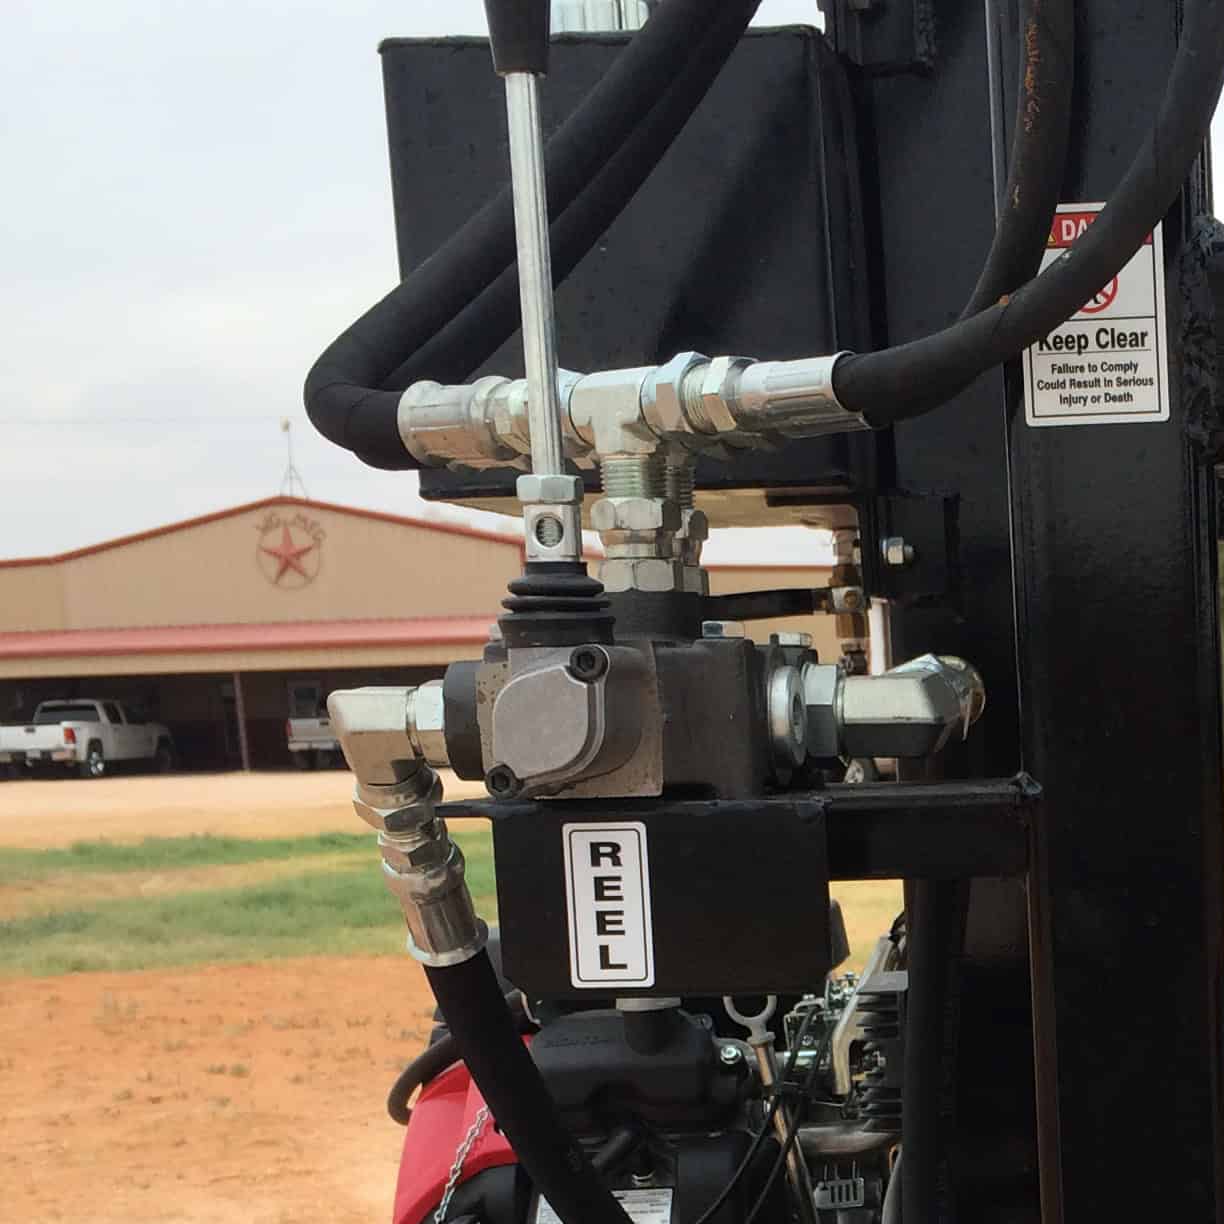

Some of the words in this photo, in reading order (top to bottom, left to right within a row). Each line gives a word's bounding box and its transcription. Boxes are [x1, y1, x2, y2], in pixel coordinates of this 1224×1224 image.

[1096, 327, 1148, 349] Clear
[1051, 362, 1085, 375] Failure
[1088, 362, 1097, 373] to
[1100, 360, 1138, 374] Comply
[1037, 379, 1066, 391] Could
[1070, 377, 1101, 389] Result
[1115, 376, 1154, 387] Serious
[1059, 394, 1089, 408] Injury
[1091, 395, 1102, 404] or
[1104, 391, 1133, 403] Death
[589, 841, 627, 970] REEL
